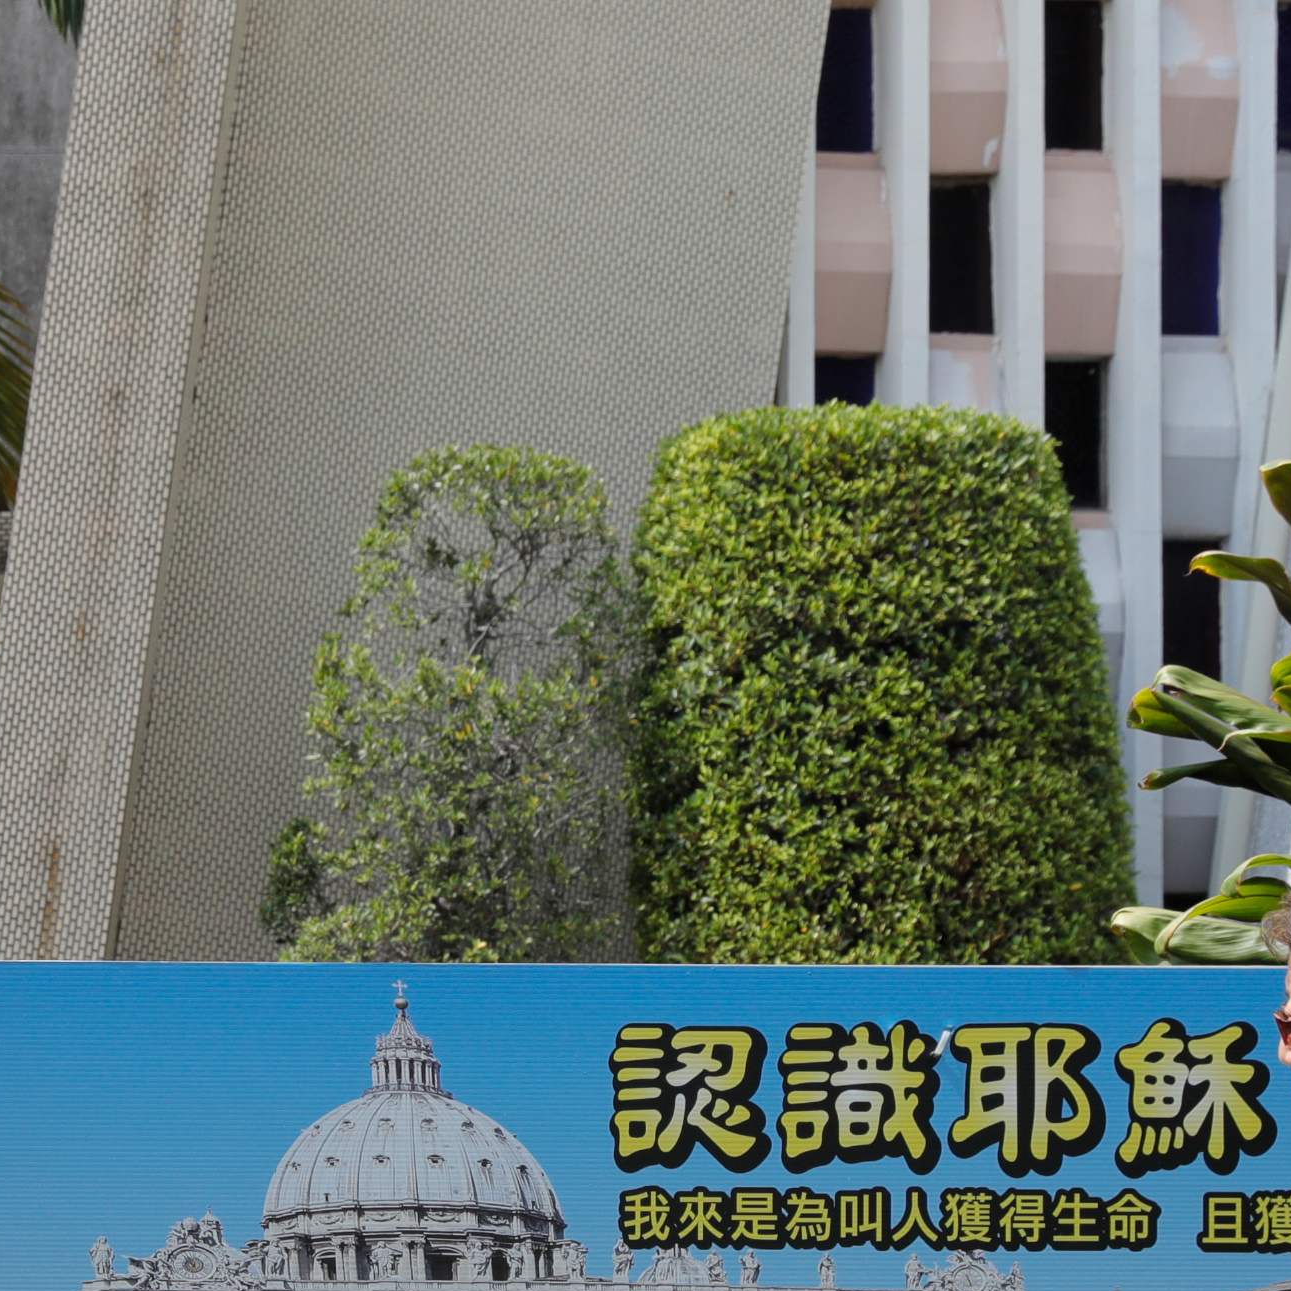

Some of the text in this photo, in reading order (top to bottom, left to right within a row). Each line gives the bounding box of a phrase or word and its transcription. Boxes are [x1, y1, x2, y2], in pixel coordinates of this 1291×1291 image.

[611, 1021, 1273, 1173] 認識耶穌
[620, 1190, 1157, 1247] 我來是為叫人獲得生命
